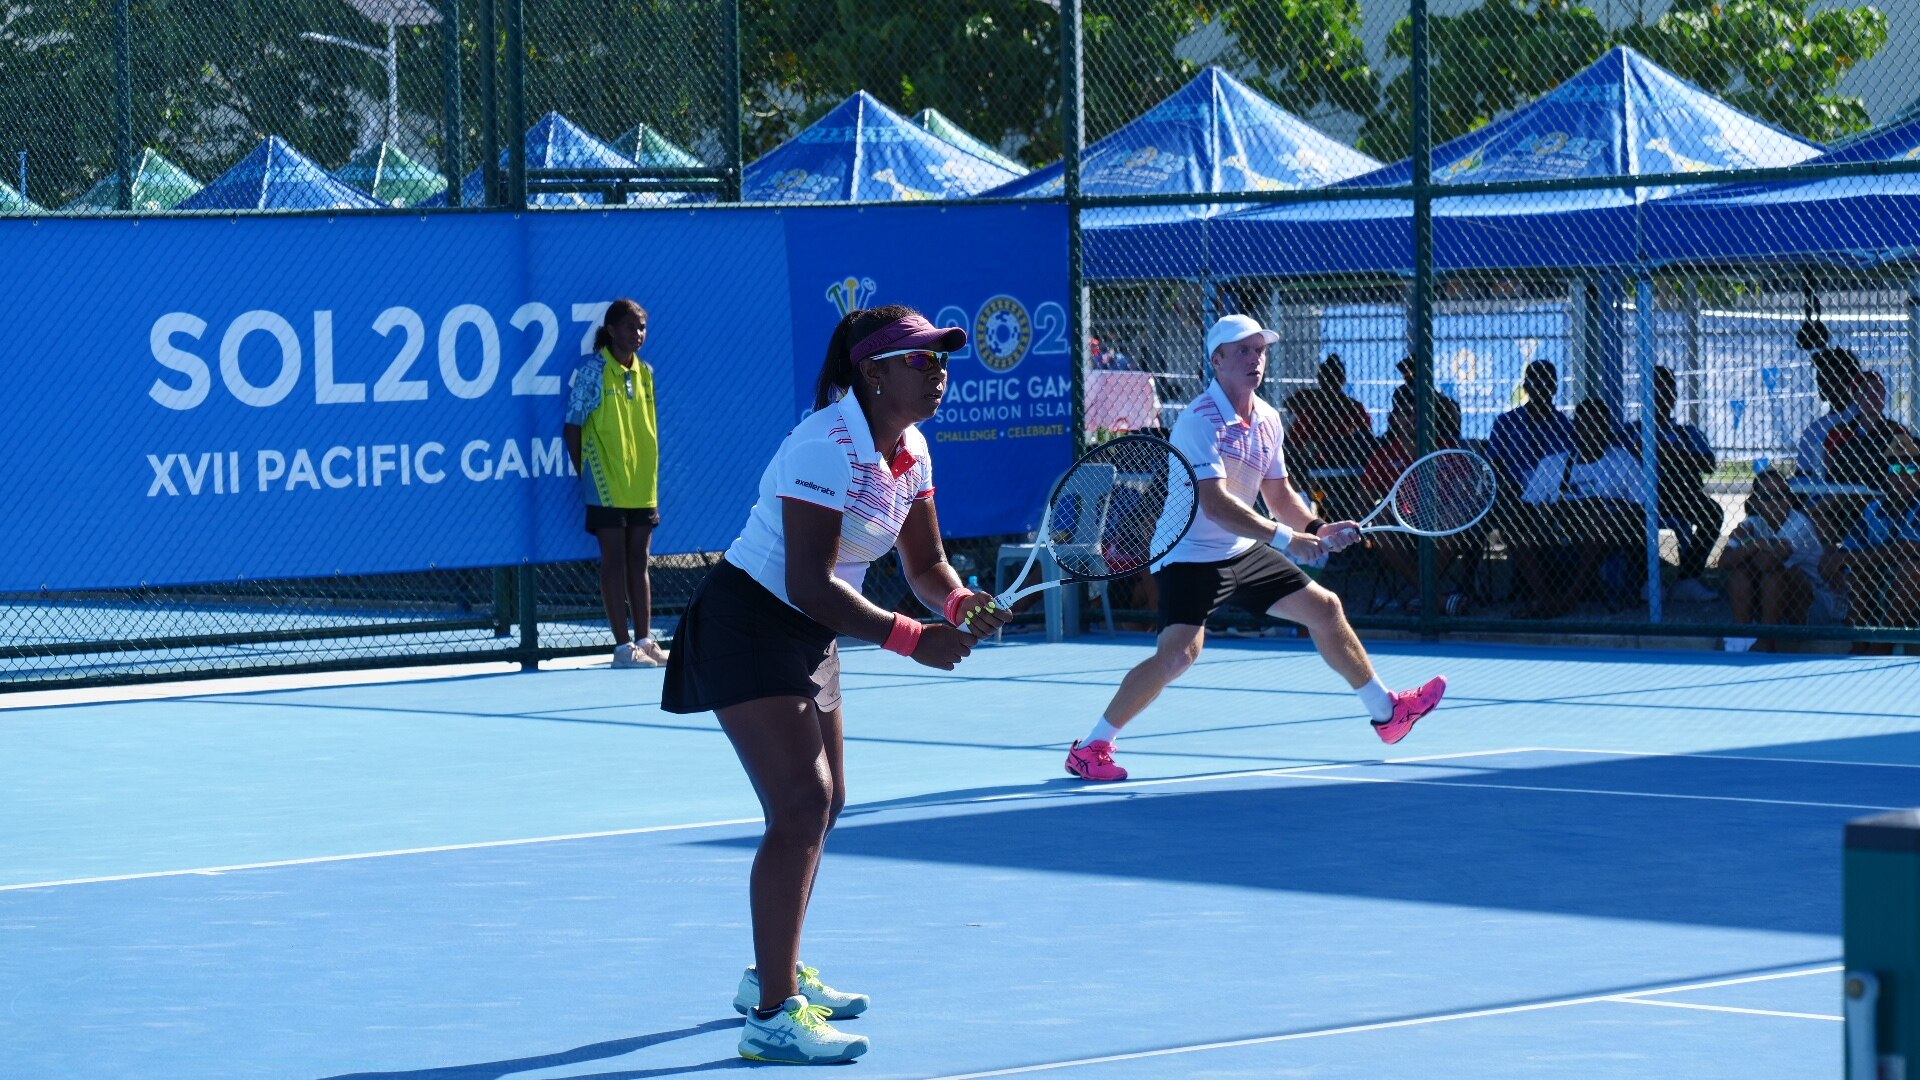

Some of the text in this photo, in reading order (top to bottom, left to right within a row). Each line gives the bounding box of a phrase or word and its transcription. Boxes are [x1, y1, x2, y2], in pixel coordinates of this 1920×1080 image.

[945, 375, 1072, 403] ACIFIC GAM
[935, 402, 1072, 424] SOLOMON ISLA
[936, 424, 1064, 443] CHALLENGE CELEBRATE
[146, 436, 578, 497] XVII PACIFIC GAM
[795, 478, 836, 497] axellerate
